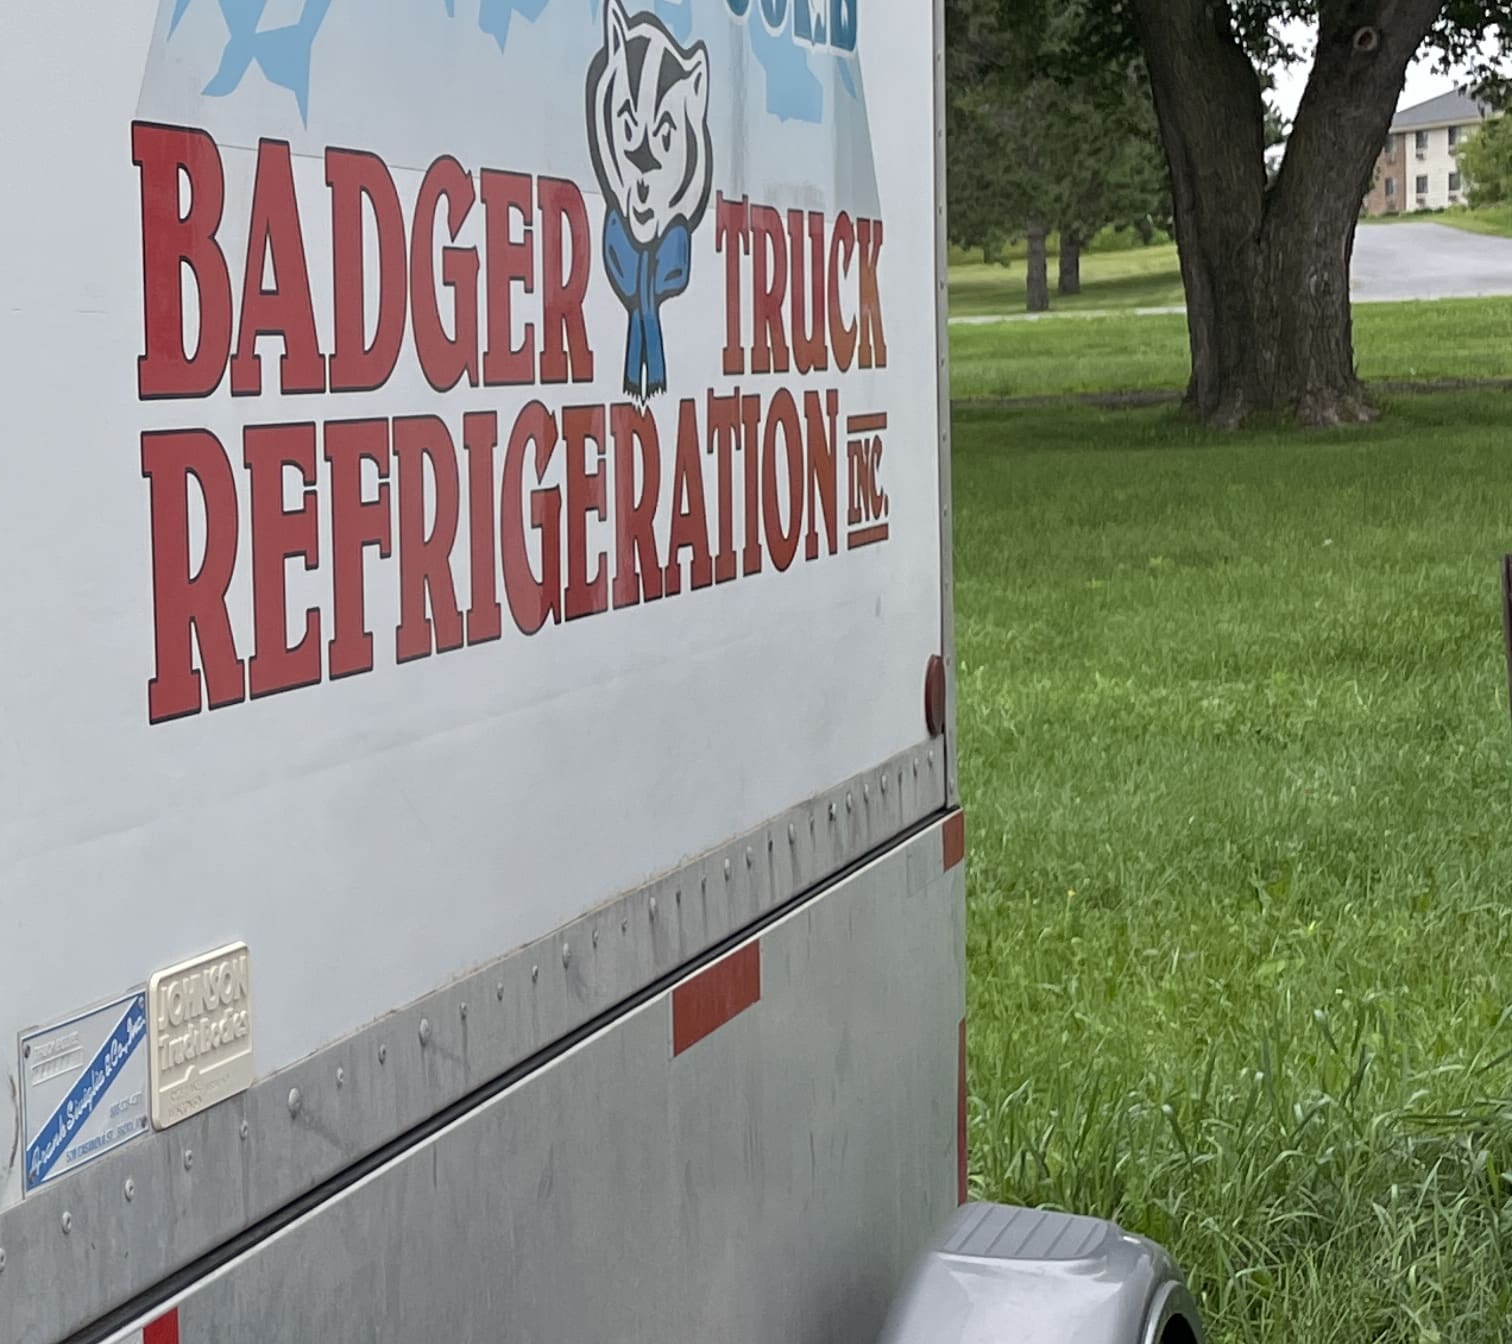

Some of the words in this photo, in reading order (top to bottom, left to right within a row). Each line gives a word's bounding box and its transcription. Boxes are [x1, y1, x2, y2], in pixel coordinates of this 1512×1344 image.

[132, 120, 594, 401] BADGER
[715, 189, 887, 376] TRUCK
[141, 387, 839, 726] REFRIGERATION
[847, 434, 889, 527] INC.
[158, 955, 248, 1031] JOHNSON
